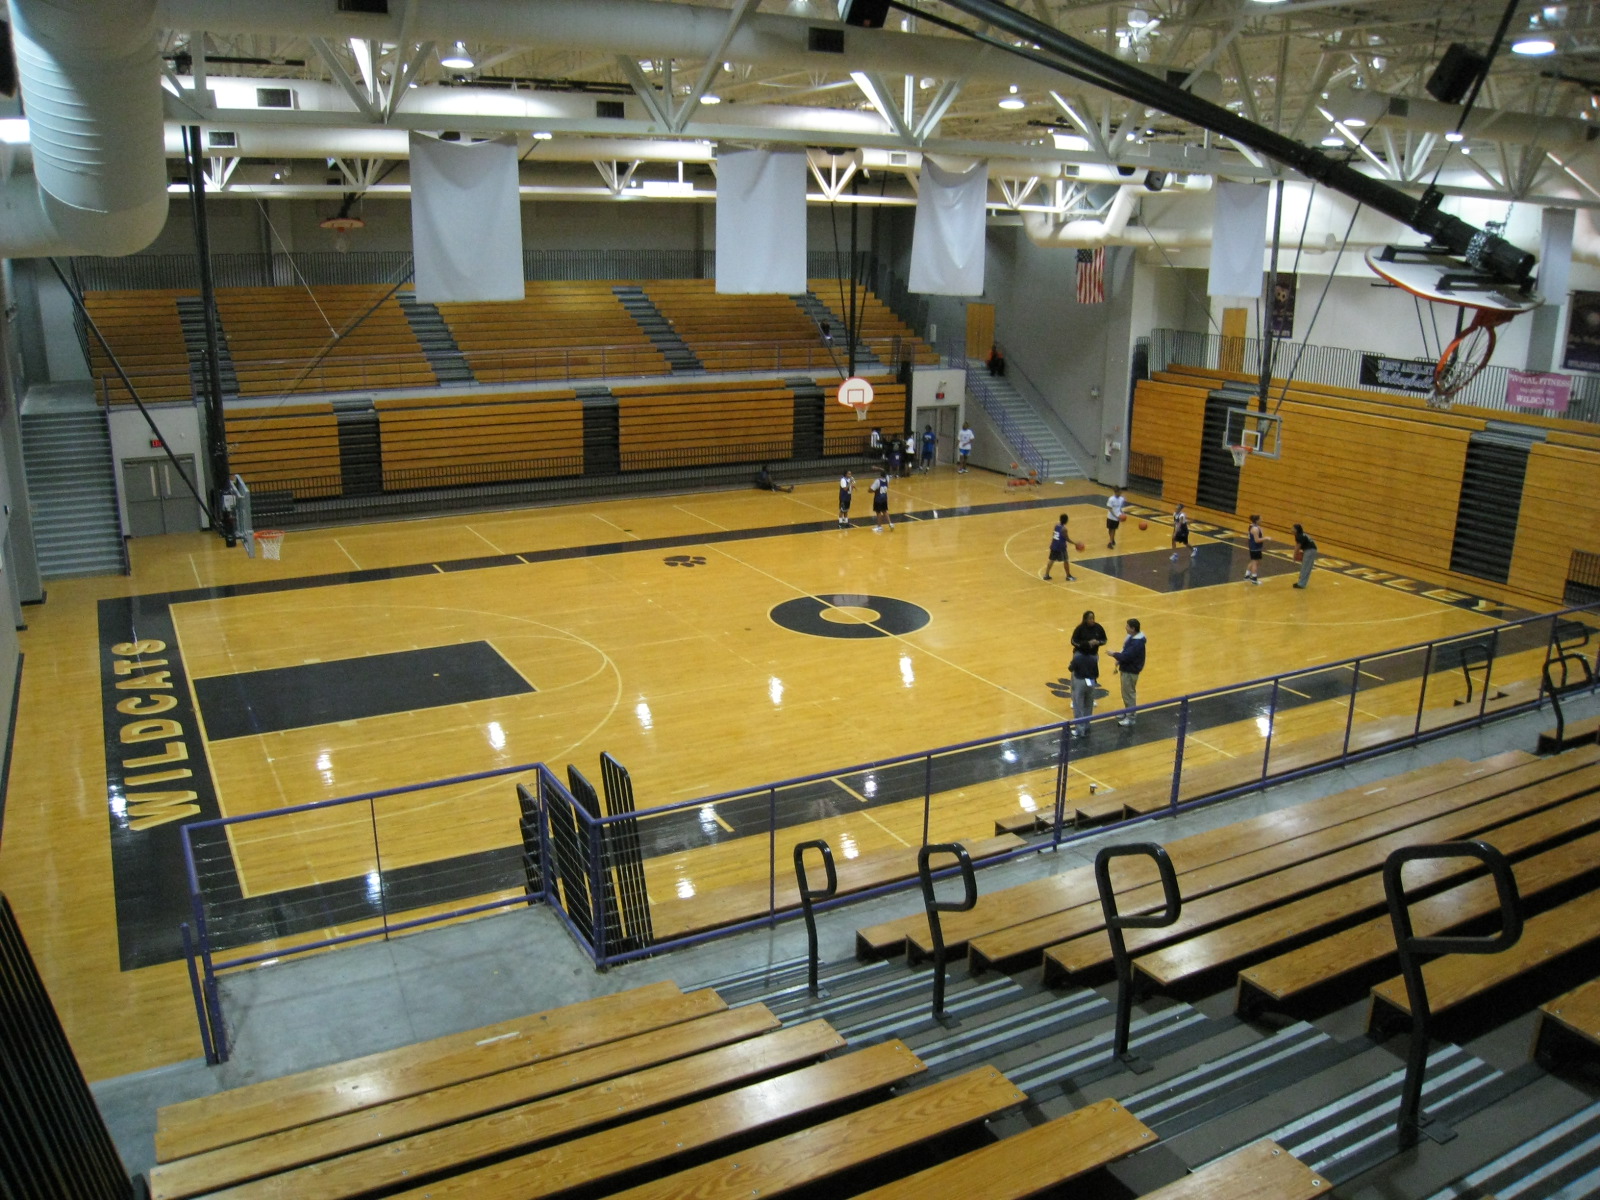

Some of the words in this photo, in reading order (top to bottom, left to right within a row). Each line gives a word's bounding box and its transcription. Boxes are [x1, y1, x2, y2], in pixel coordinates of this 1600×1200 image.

[1539, 377, 1570, 387] FITNESS
[1516, 395, 1555, 406] WILDCATS
[111, 639, 201, 831] WILDCATS
